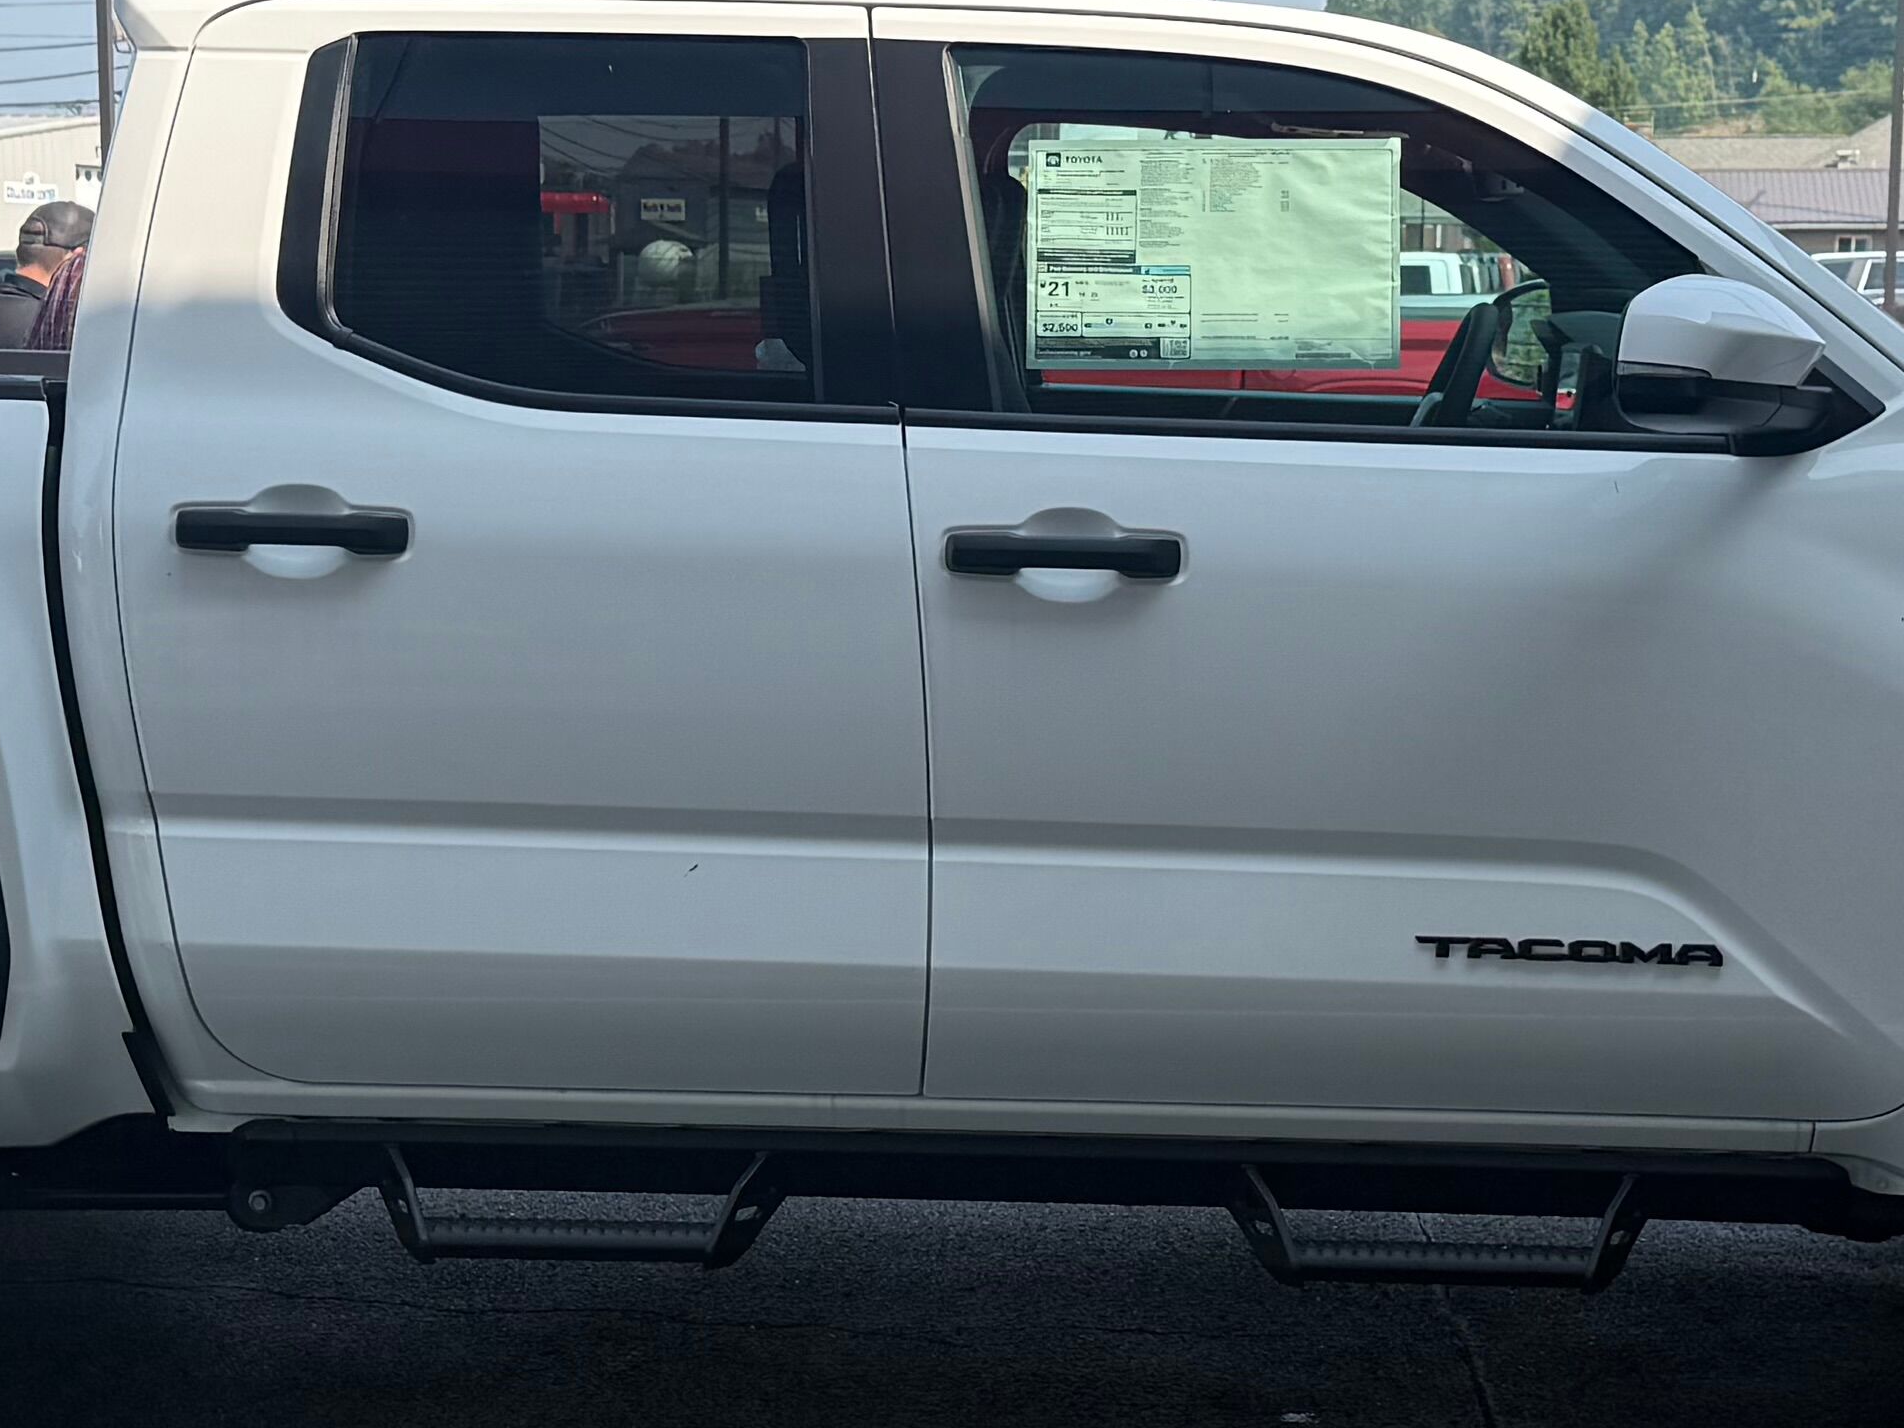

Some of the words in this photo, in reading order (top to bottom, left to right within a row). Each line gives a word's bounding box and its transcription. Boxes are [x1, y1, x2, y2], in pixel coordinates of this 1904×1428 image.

[1065, 156, 1103, 164] TOYOTA
[1048, 281, 1070, 297] 21
[1415, 935, 1724, 967] TACOMA
